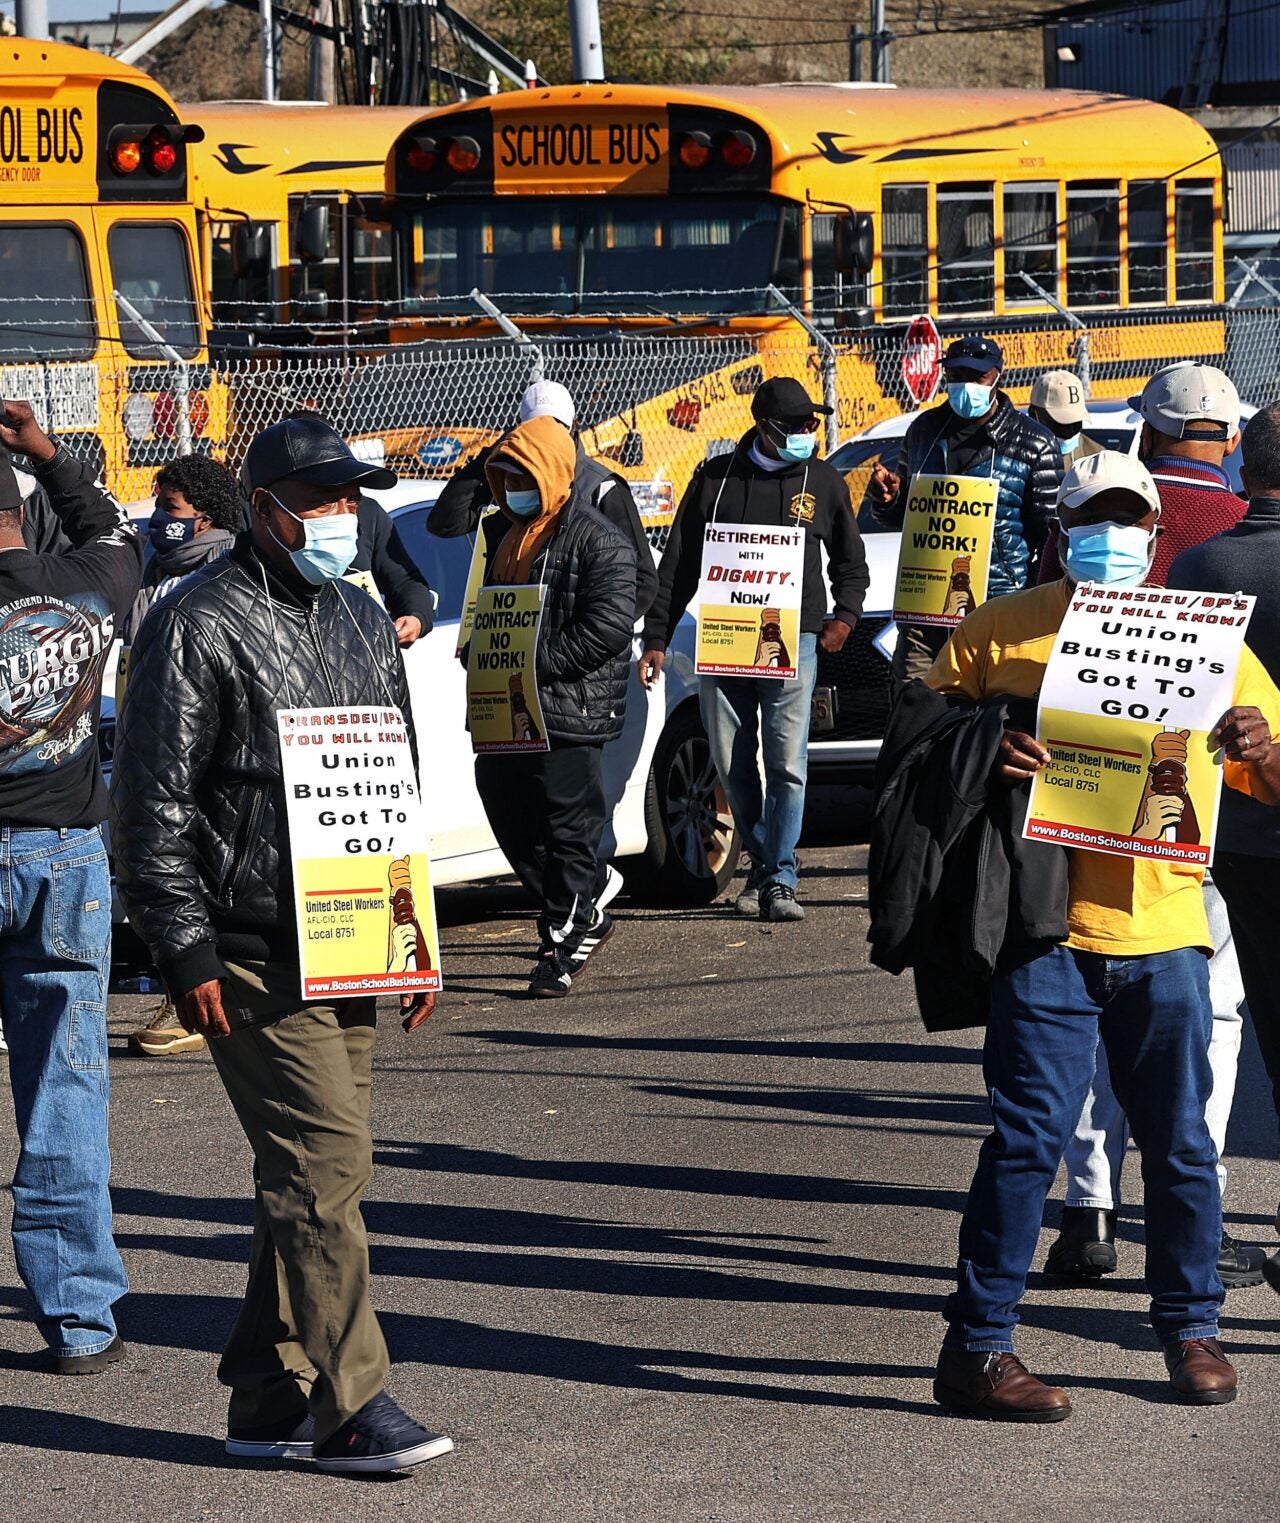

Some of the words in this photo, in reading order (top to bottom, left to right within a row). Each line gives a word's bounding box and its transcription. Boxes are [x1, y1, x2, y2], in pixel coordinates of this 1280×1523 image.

[37, 107, 83, 164] BUS
[501, 124, 601, 167] SCHOOL
[609, 122, 660, 165] BUS
[21, 167, 41, 182] DOOR
[907, 343, 936, 376] STOP
[1068, 385, 1081, 404] B
[837, 397, 865, 428] S245
[932, 481, 960, 497] NO
[908, 497, 993, 517] CONTRACT
[928, 517, 956, 533] NO
[706, 528, 801, 546] RETIREMENT
[912, 533, 977, 552] WORK!
[739, 551, 764, 560] WITH
[10, 595, 42, 610] LEGEND
[493, 592, 516, 610] NO
[730, 591, 770, 605] NOW!
[475, 610, 540, 630] CONTRACT
[1073, 602, 1113, 614] YOU
[1121, 607, 1166, 619] WILL
[1177, 612, 1247, 627] KNOW!
[735, 624, 756, 632] Workers
[1101, 622, 1198, 644] Union
[490, 632, 510, 650] NO
[477, 651, 525, 670] WORK!
[1060, 641, 1225, 674] Busting's
[17, 664, 80, 706] 2018
[1077, 668, 1137, 690] Got
[1155, 678, 1195, 698] To
[1100, 700, 1170, 723] GO!
[283, 733, 323, 746] YOU
[332, 733, 372, 743] WILL
[321, 753, 395, 768] Union
[1078, 753, 1101, 767] Steel
[1103, 758, 1141, 774] Workers
[1083, 768, 1101, 778] CLC
[294, 780, 413, 799] Busting's
[1044, 774, 1073, 788] Local
[1076, 779, 1099, 792] 8751
[318, 810, 368, 826] Got
[381, 808, 406, 823] To
[345, 837, 394, 853] GO!
[1031, 824, 1207, 862] www.BostonSchoolBusUnion.org
[306, 900, 331, 913] United
[333, 899, 352, 911] Steel
[355, 898, 384, 910] Workers
[308, 929, 333, 939] Local
[335, 928, 355, 937] 8751
[307, 976, 438, 992] www.BostonSchoolBusUnion.org
